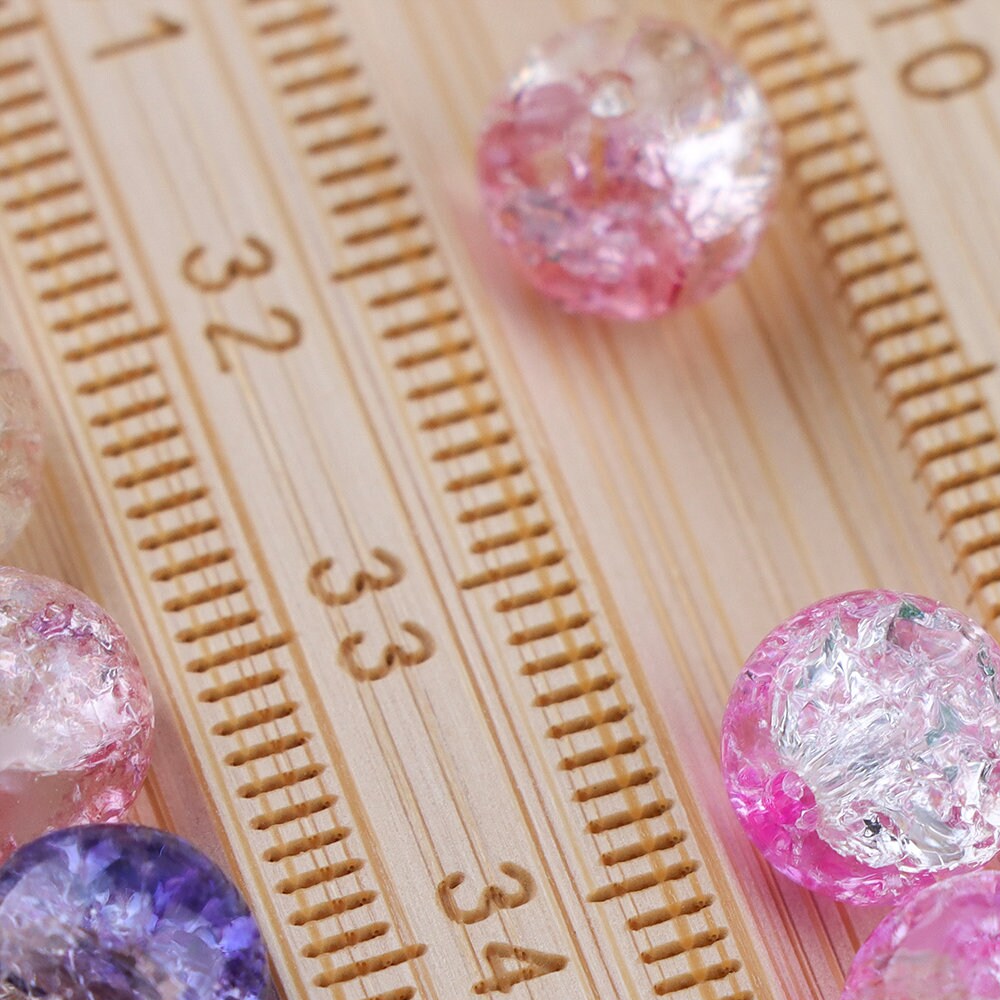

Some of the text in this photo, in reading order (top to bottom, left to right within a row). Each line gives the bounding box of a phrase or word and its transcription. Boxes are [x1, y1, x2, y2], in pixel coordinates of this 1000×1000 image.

[870, 0, 995, 101] 10
[181, 235, 304, 375] 32
[306, 546, 438, 682] 33
[435, 860, 569, 995] 34
